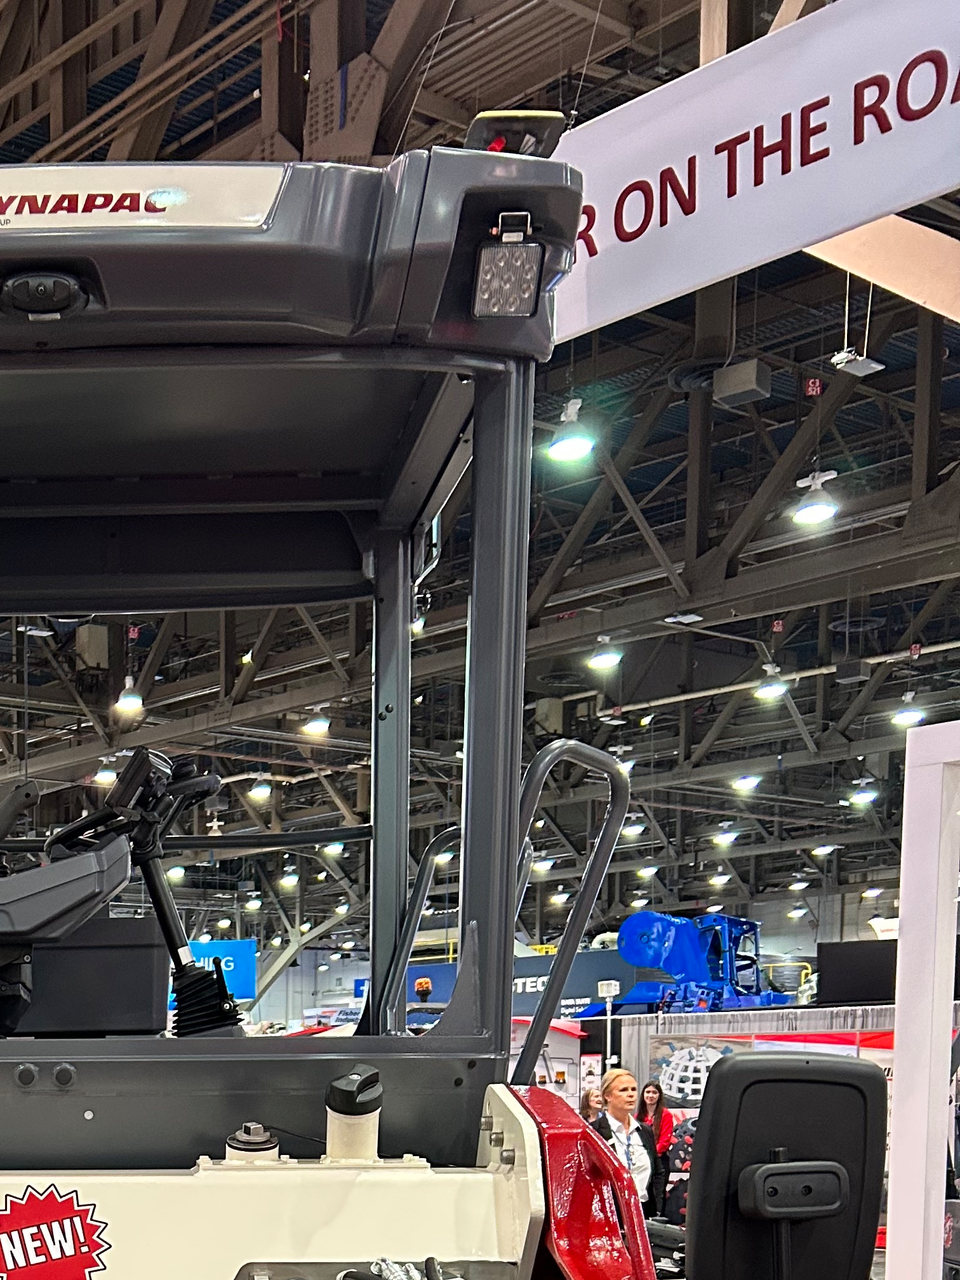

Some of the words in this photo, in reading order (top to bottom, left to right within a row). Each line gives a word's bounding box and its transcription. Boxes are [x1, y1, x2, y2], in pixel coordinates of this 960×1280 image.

[614, 154, 697, 243] ON
[714, 95, 831, 199] THE
[853, 49, 960, 146] RO
